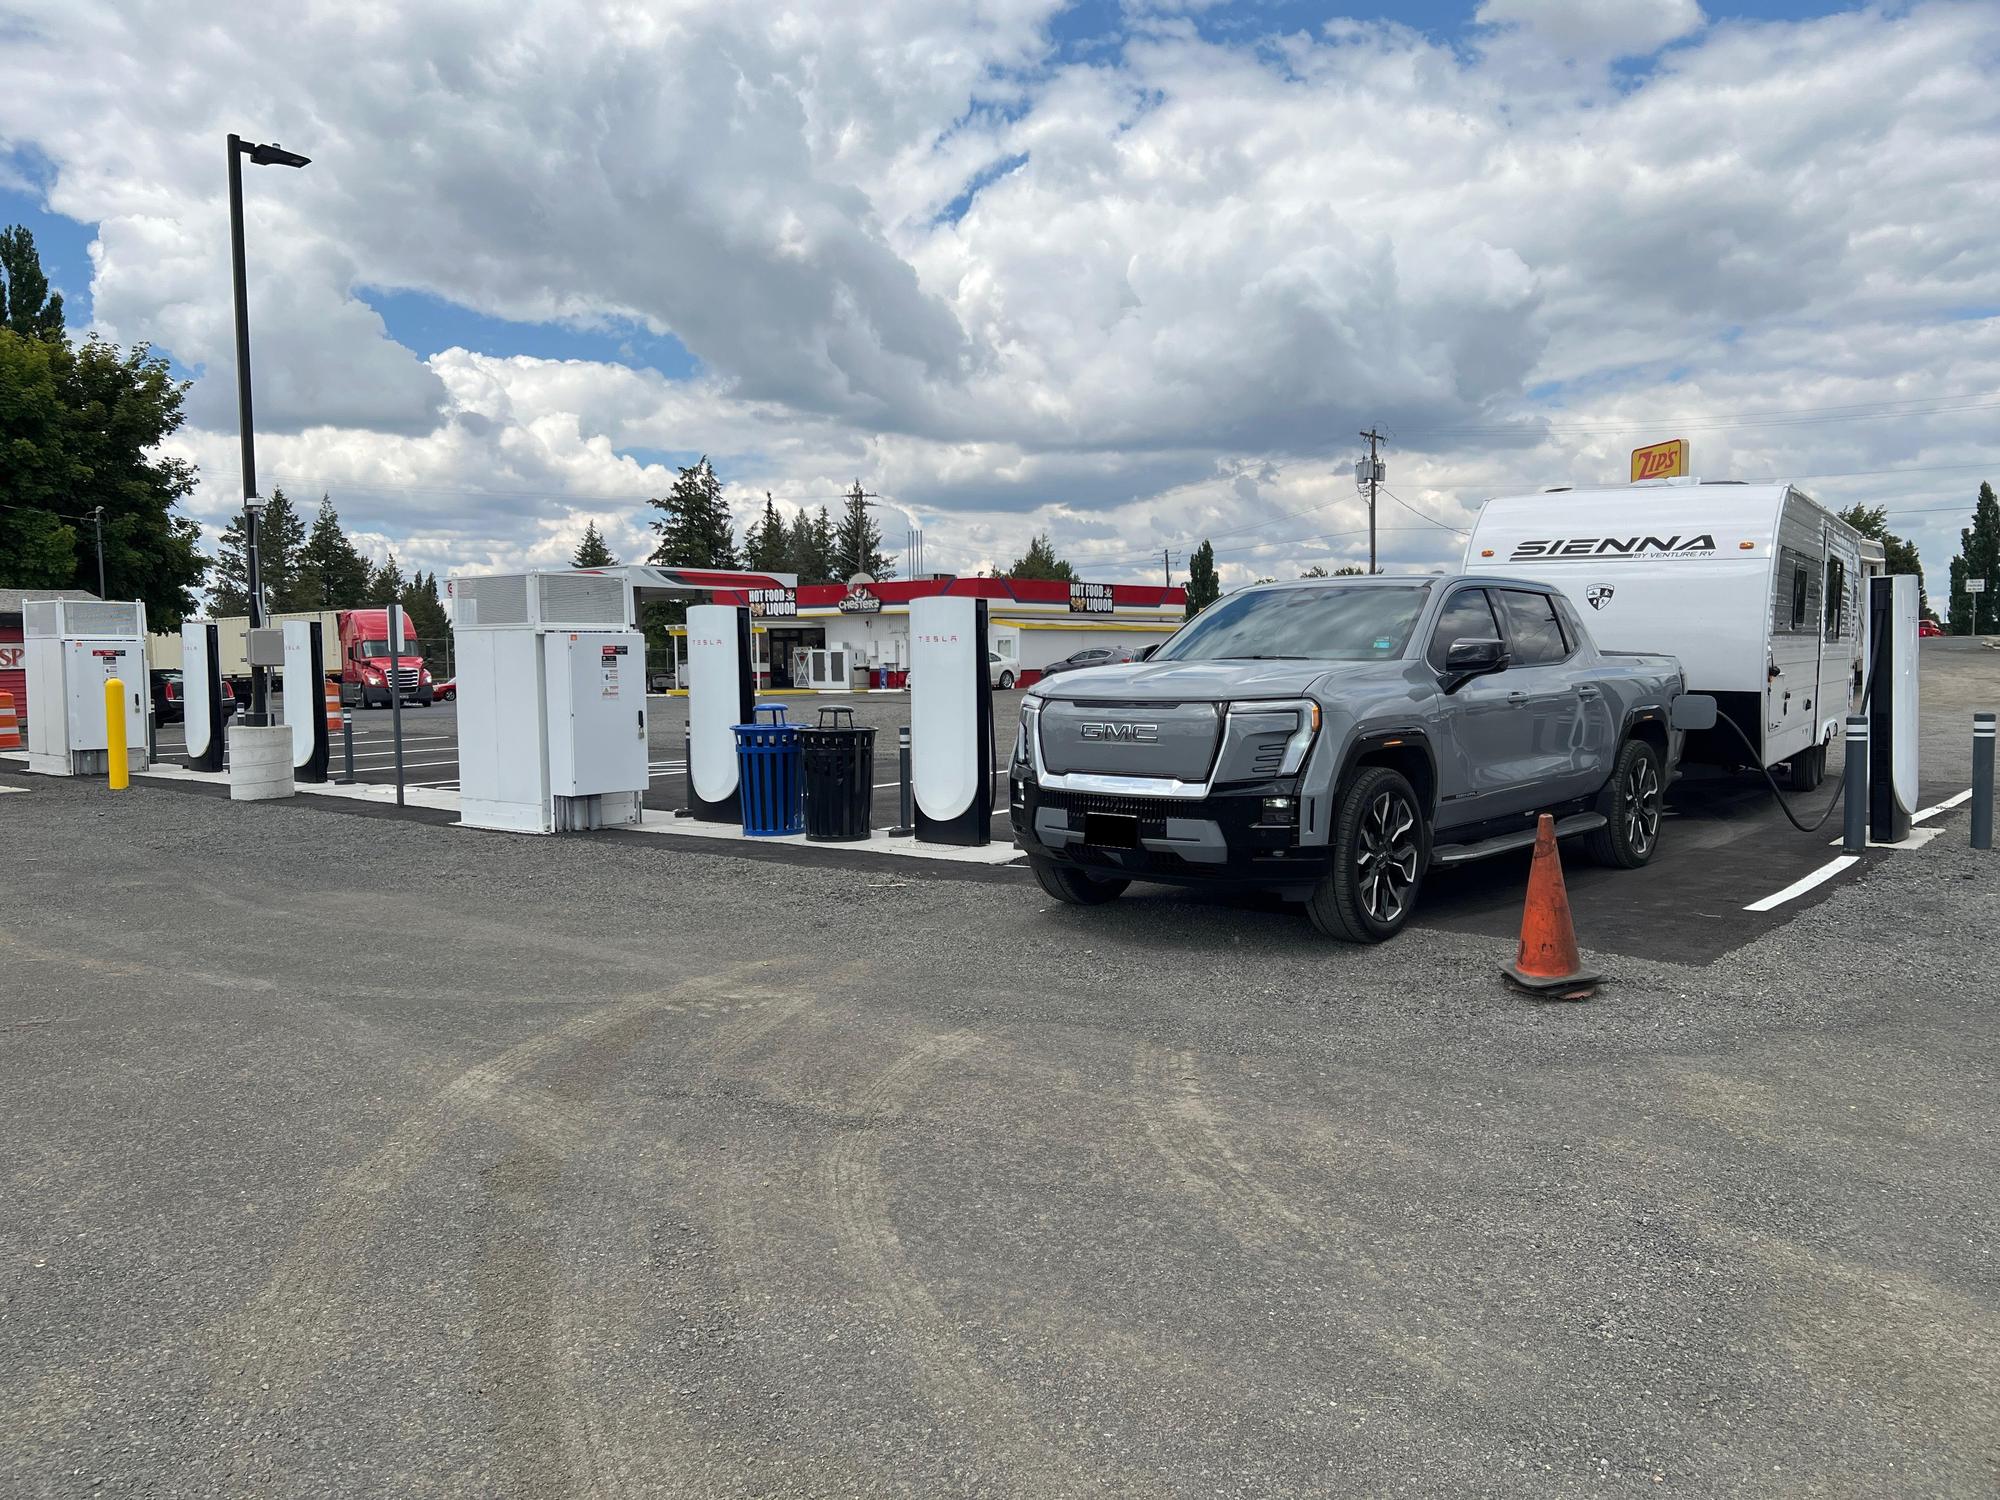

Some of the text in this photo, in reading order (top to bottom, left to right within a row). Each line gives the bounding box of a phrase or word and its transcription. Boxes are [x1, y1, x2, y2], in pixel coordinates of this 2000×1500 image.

[1637, 447, 1678, 480] ZIP'S
[1510, 534, 1716, 556] SIENNA
[748, 589, 785, 603] HOT FOOD
[1070, 583, 1104, 598] HOT FOOD
[766, 602, 796, 617] LIQUOR
[1086, 598, 1113, 612] LIQUOR
[917, 635, 958, 643] TESLA
[1080, 722, 1159, 743] GMC
